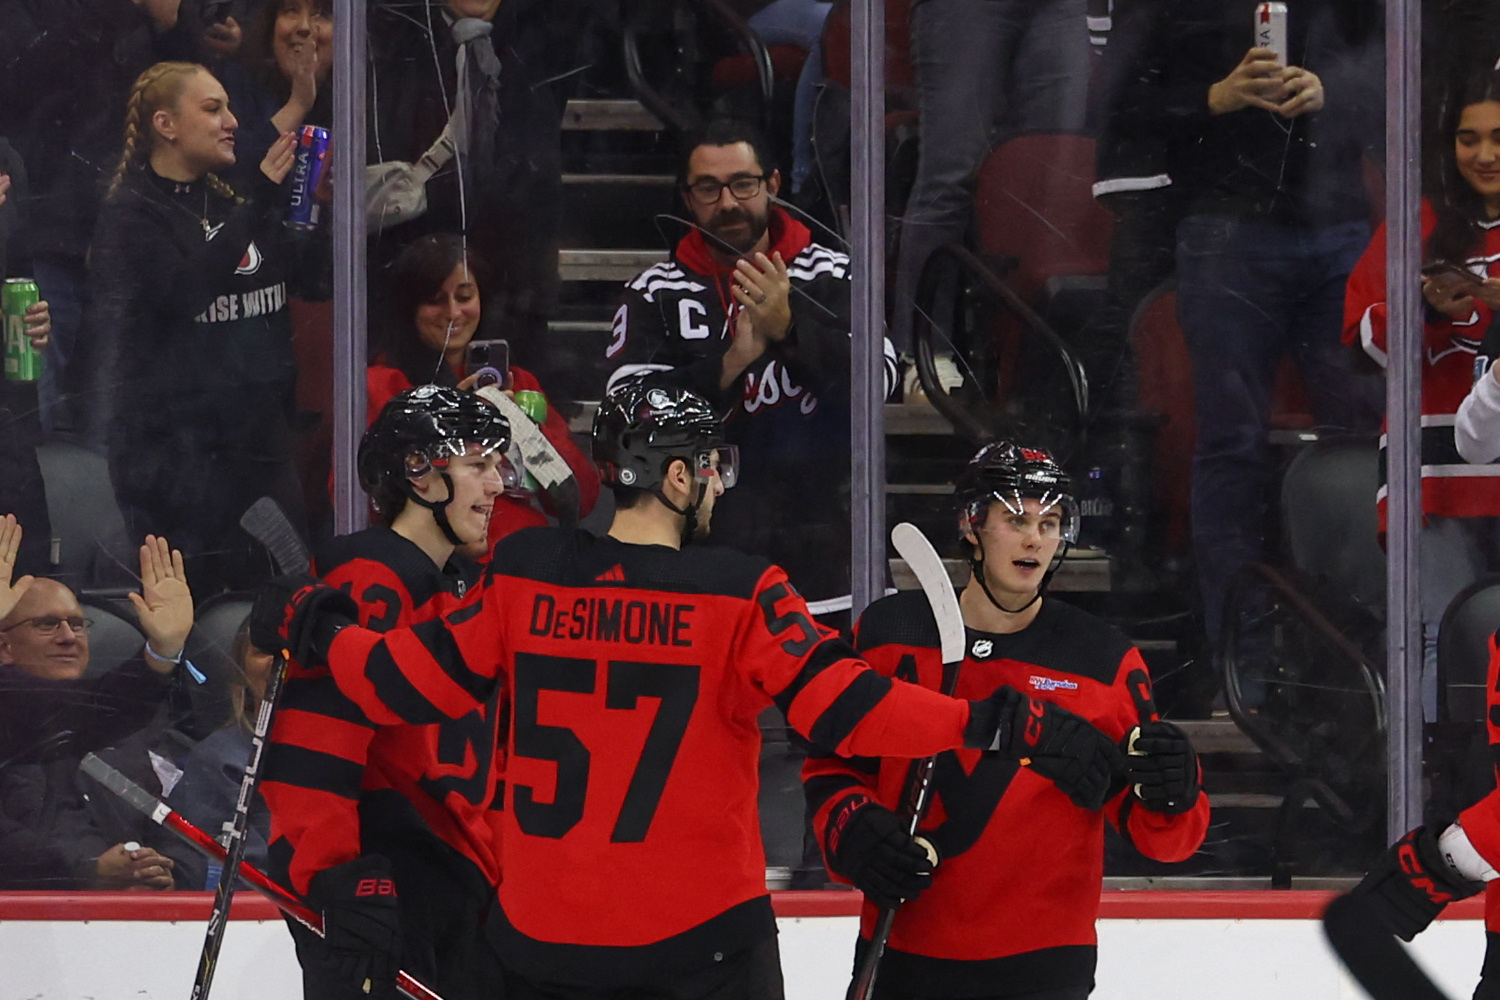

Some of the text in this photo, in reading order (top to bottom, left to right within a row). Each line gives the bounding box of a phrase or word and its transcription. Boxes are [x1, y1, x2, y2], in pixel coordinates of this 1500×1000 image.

[290, 152, 310, 207] ULTRA
[678, 298, 710, 340] C
[530, 594, 693, 648] DeSIMONE
[512, 652, 701, 843] 57
